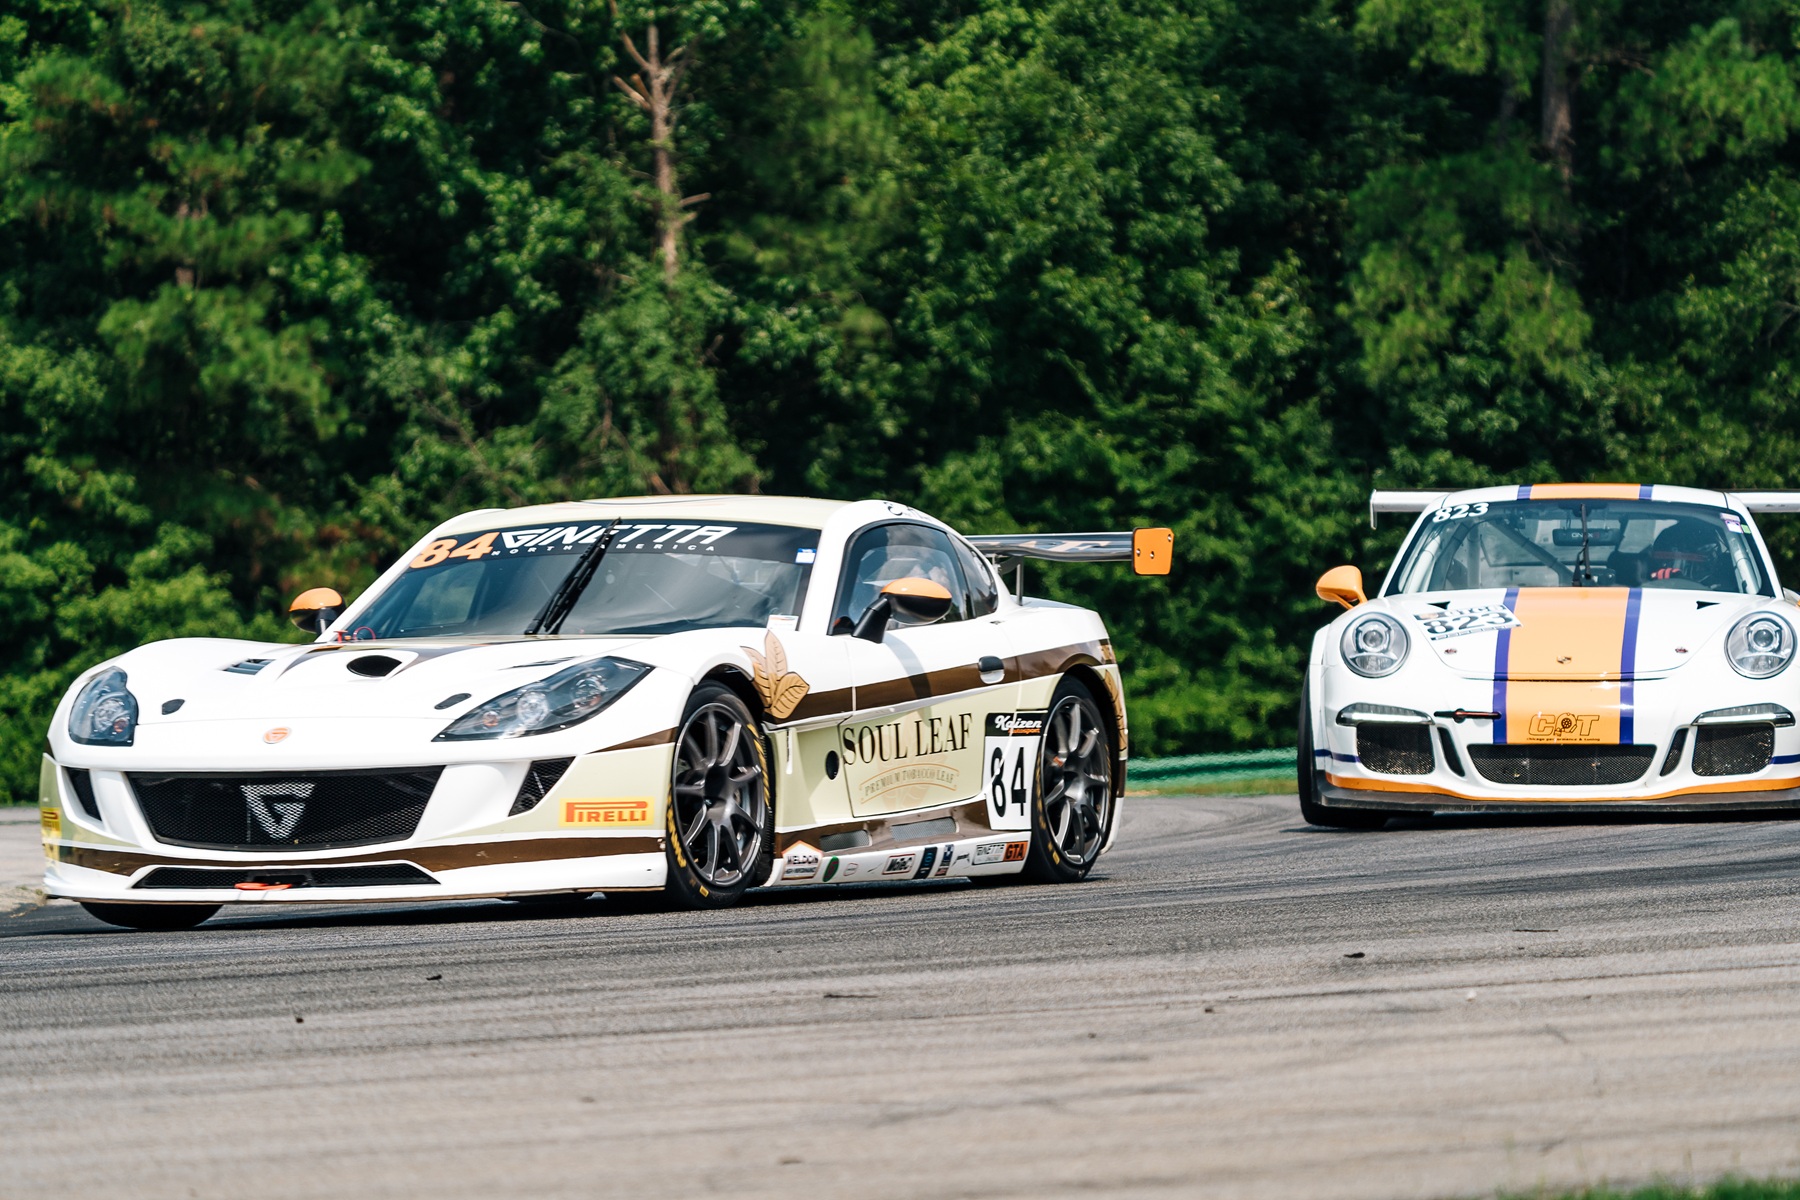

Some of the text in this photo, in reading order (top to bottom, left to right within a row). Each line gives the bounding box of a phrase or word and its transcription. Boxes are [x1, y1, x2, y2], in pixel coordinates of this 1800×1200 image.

[1433, 502, 1489, 523] 823
[501, 524, 738, 549] GINETTA
[409, 531, 501, 569] 84
[491, 545, 573, 556] NORTH
[1423, 612, 1513, 634] 823
[994, 714, 1043, 731] Kaizen
[843, 712, 973, 765] SOUL LEAF
[864, 772, 900, 796] PREMIUM
[936, 769, 955, 784] LEAF
[991, 746, 1026, 818] 84
[565, 801, 648, 822] PIRELLI
[786, 855, 819, 865] WELDON
[1006, 843, 1024, 859] GTA
